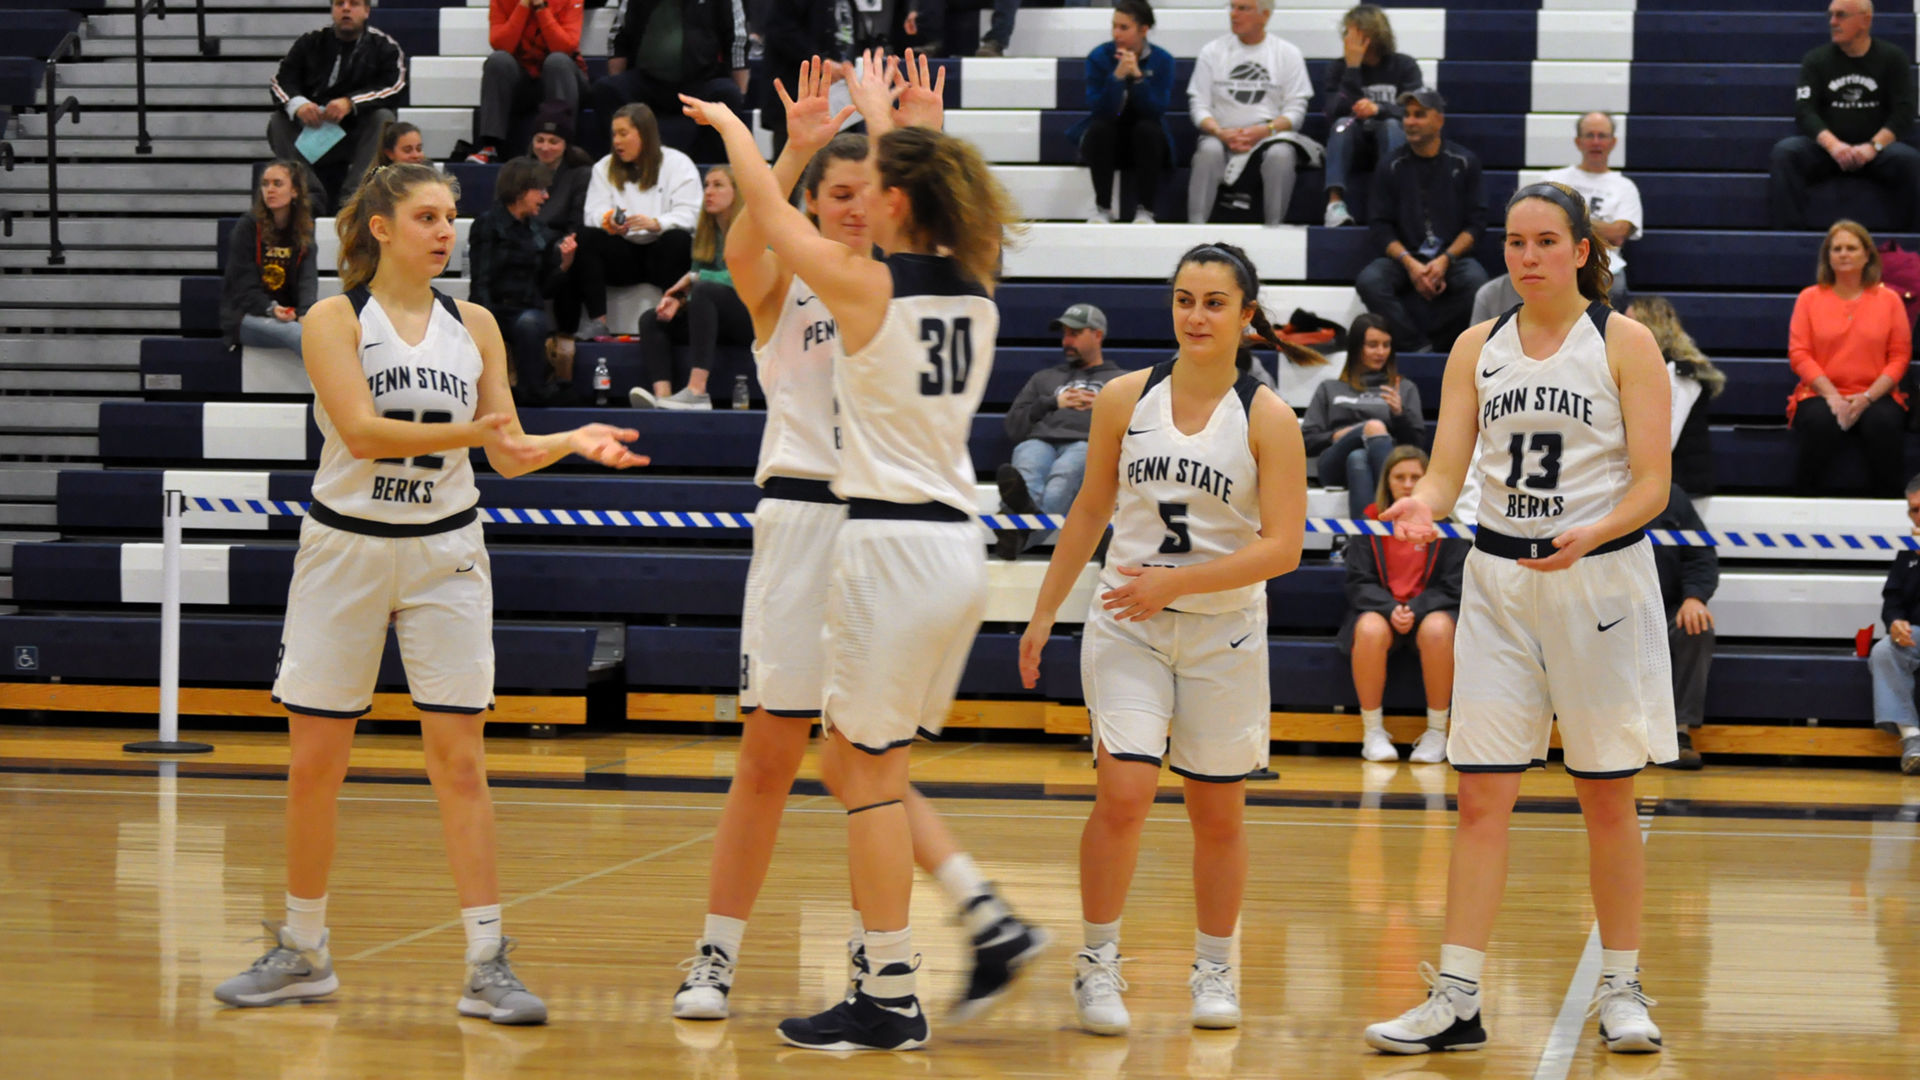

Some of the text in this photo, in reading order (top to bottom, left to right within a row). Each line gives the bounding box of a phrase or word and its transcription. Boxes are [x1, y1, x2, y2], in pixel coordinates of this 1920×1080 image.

[804, 319, 839, 351] PEN
[920, 316, 973, 395] 30
[416, 367, 469, 407] STATE
[1483, 386, 1593, 429] PENN STATE
[1128, 456, 1233, 505] PENN STATE
[1505, 431, 1564, 490] 13
[371, 475, 434, 504] BERKS
[1505, 494, 1564, 518] BERKS
[1157, 500, 1193, 554] 5
